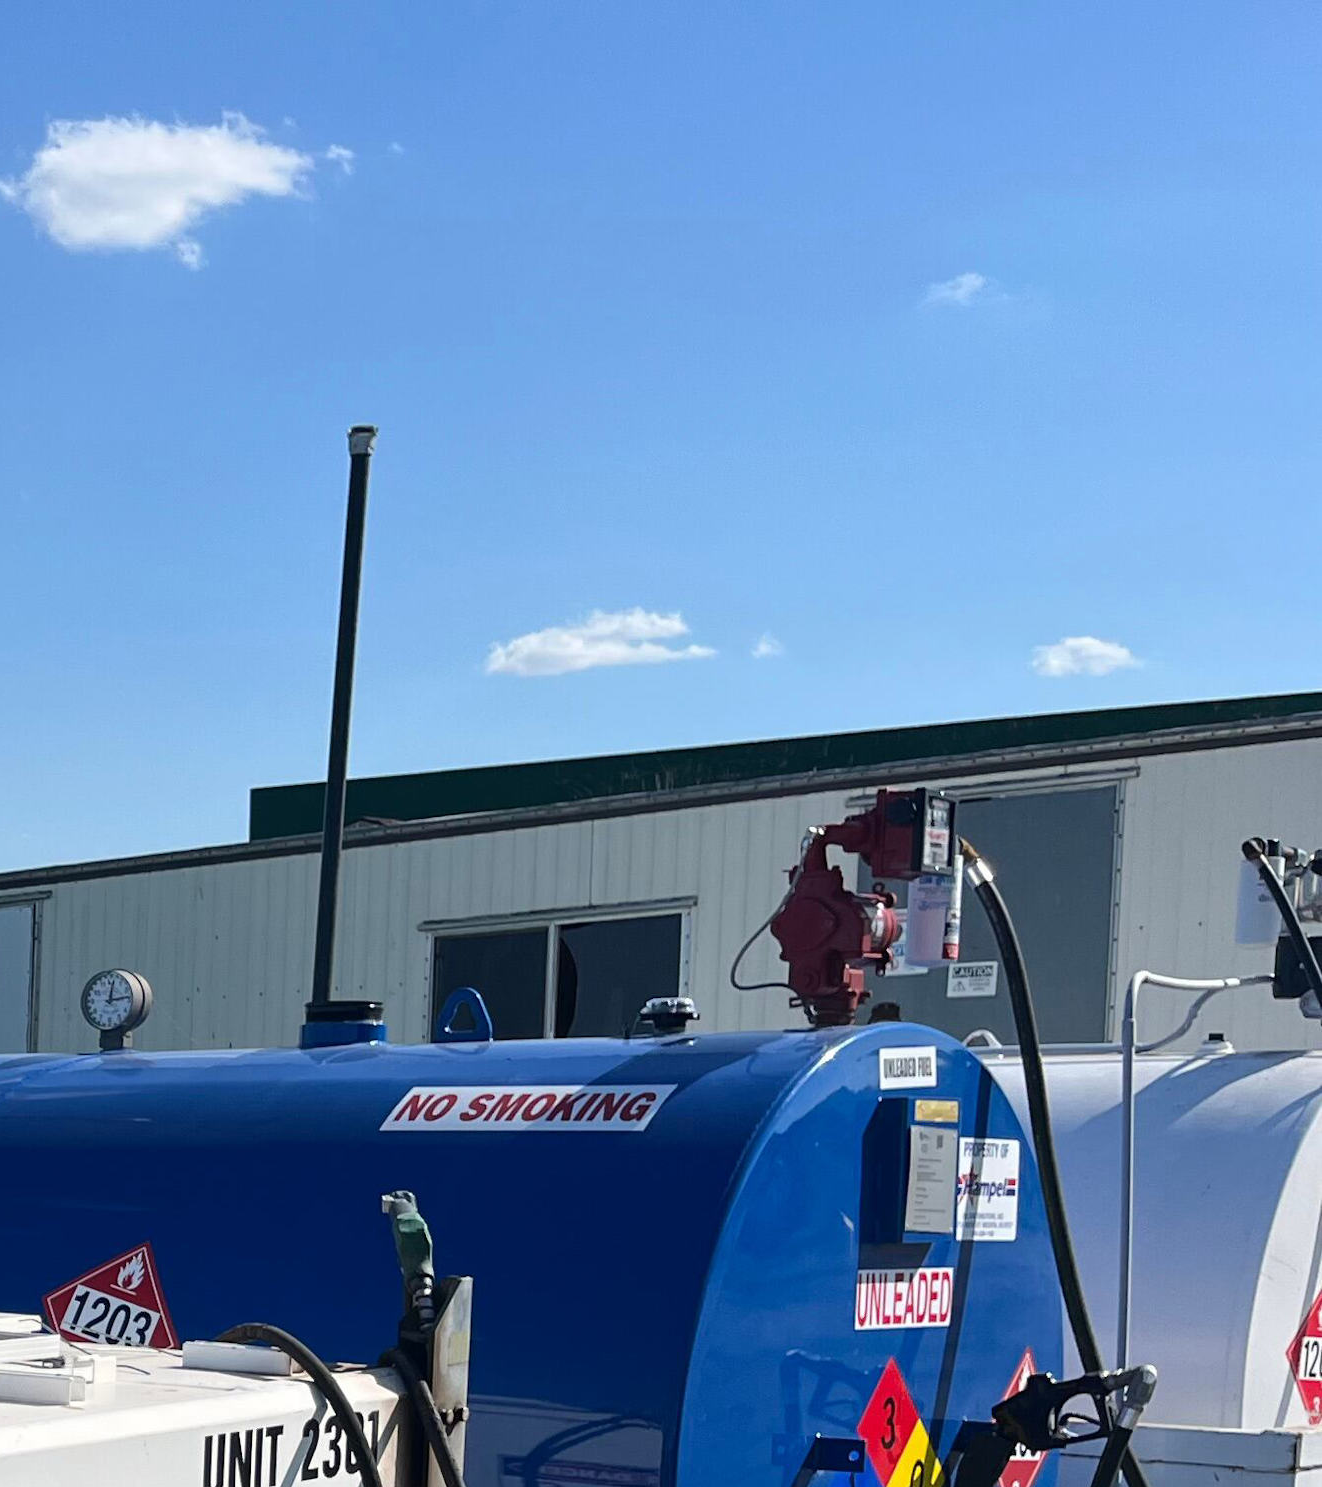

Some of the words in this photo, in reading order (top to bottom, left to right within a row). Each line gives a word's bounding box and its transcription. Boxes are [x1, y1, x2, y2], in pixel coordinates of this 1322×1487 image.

[952, 966, 993, 978] CAUTION
[918, 1056, 932, 1077] FUEL
[393, 1094, 458, 1122] NO
[459, 1092, 657, 1122] SMOKING
[857, 1271, 951, 1327] UNLEADED
[72, 1290, 153, 1347] 1203
[1304, 1340, 1322, 1377] 12
[881, 1397, 895, 1450] 3
